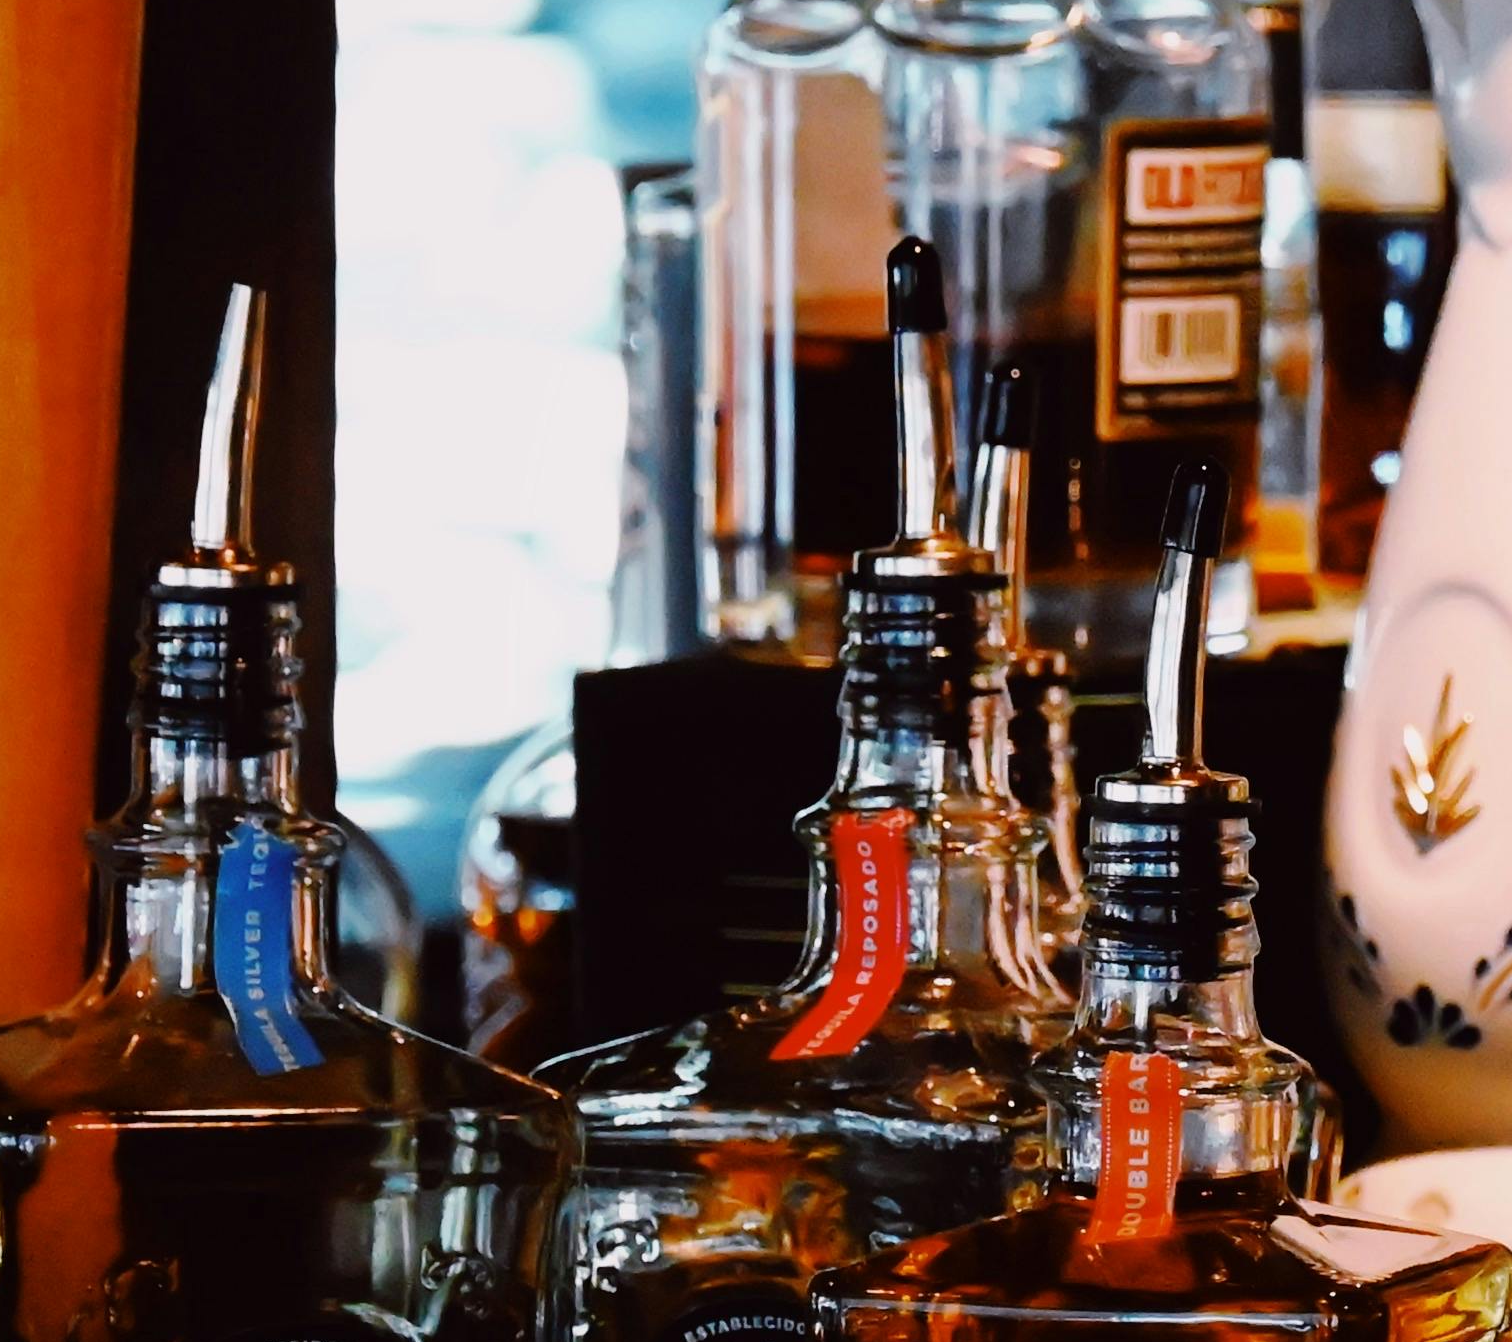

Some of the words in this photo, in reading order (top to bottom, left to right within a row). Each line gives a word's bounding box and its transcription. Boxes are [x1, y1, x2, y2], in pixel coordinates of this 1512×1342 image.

[244, 911, 264, 1000] SILVER
[855, 840, 879, 985] REPOSADO
[1116, 1128, 1149, 1236] DOUBLE
